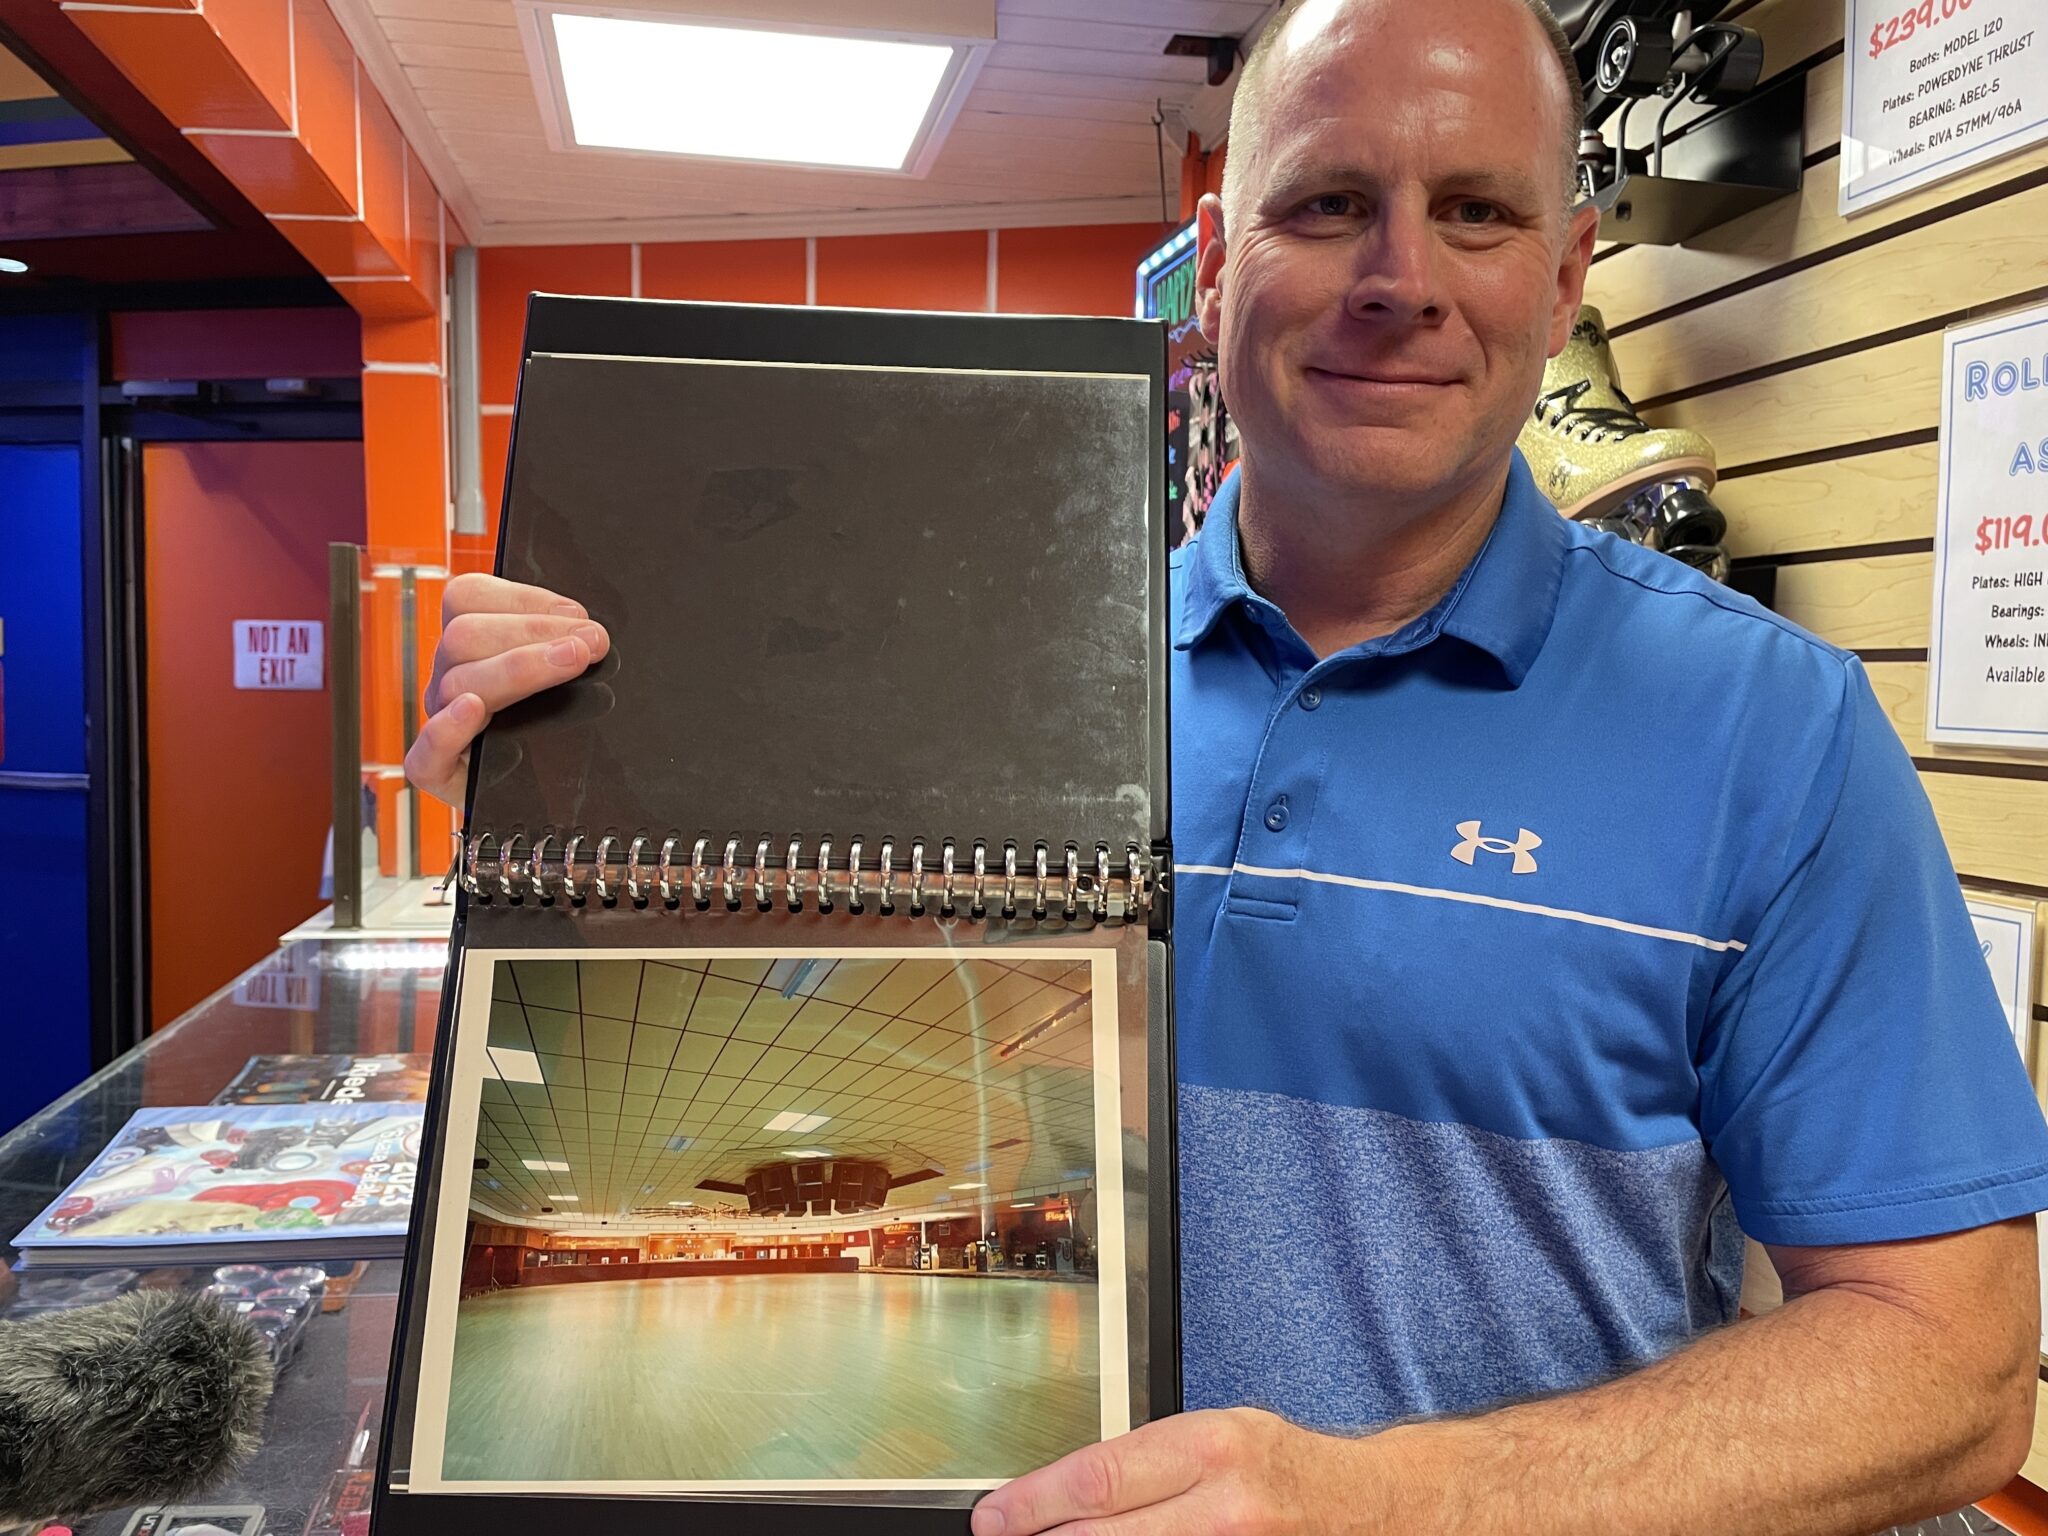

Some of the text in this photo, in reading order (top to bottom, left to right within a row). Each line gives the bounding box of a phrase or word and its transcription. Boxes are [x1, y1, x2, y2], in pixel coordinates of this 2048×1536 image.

[1909, 17, 2003, 73] Boots: MODEL 120
[1882, 31, 2035, 113] Plates: POWERDYNE THRUST
[1908, 78, 2000, 129] BEARING: ABEC-5
[1889, 142, 1925, 165] Wheels:
[1928, 128, 1952, 149] RIVA
[1965, 353, 2048, 402] ROL
[1972, 571, 2043, 590] Plates: HIGH
[1991, 603, 2045, 620] Bearings:
[248, 626, 310, 655] NOT AN
[1984, 633, 2029, 648] Wheels:
[260, 658, 296, 685] EXIT
[1985, 665, 2046, 683] Available
